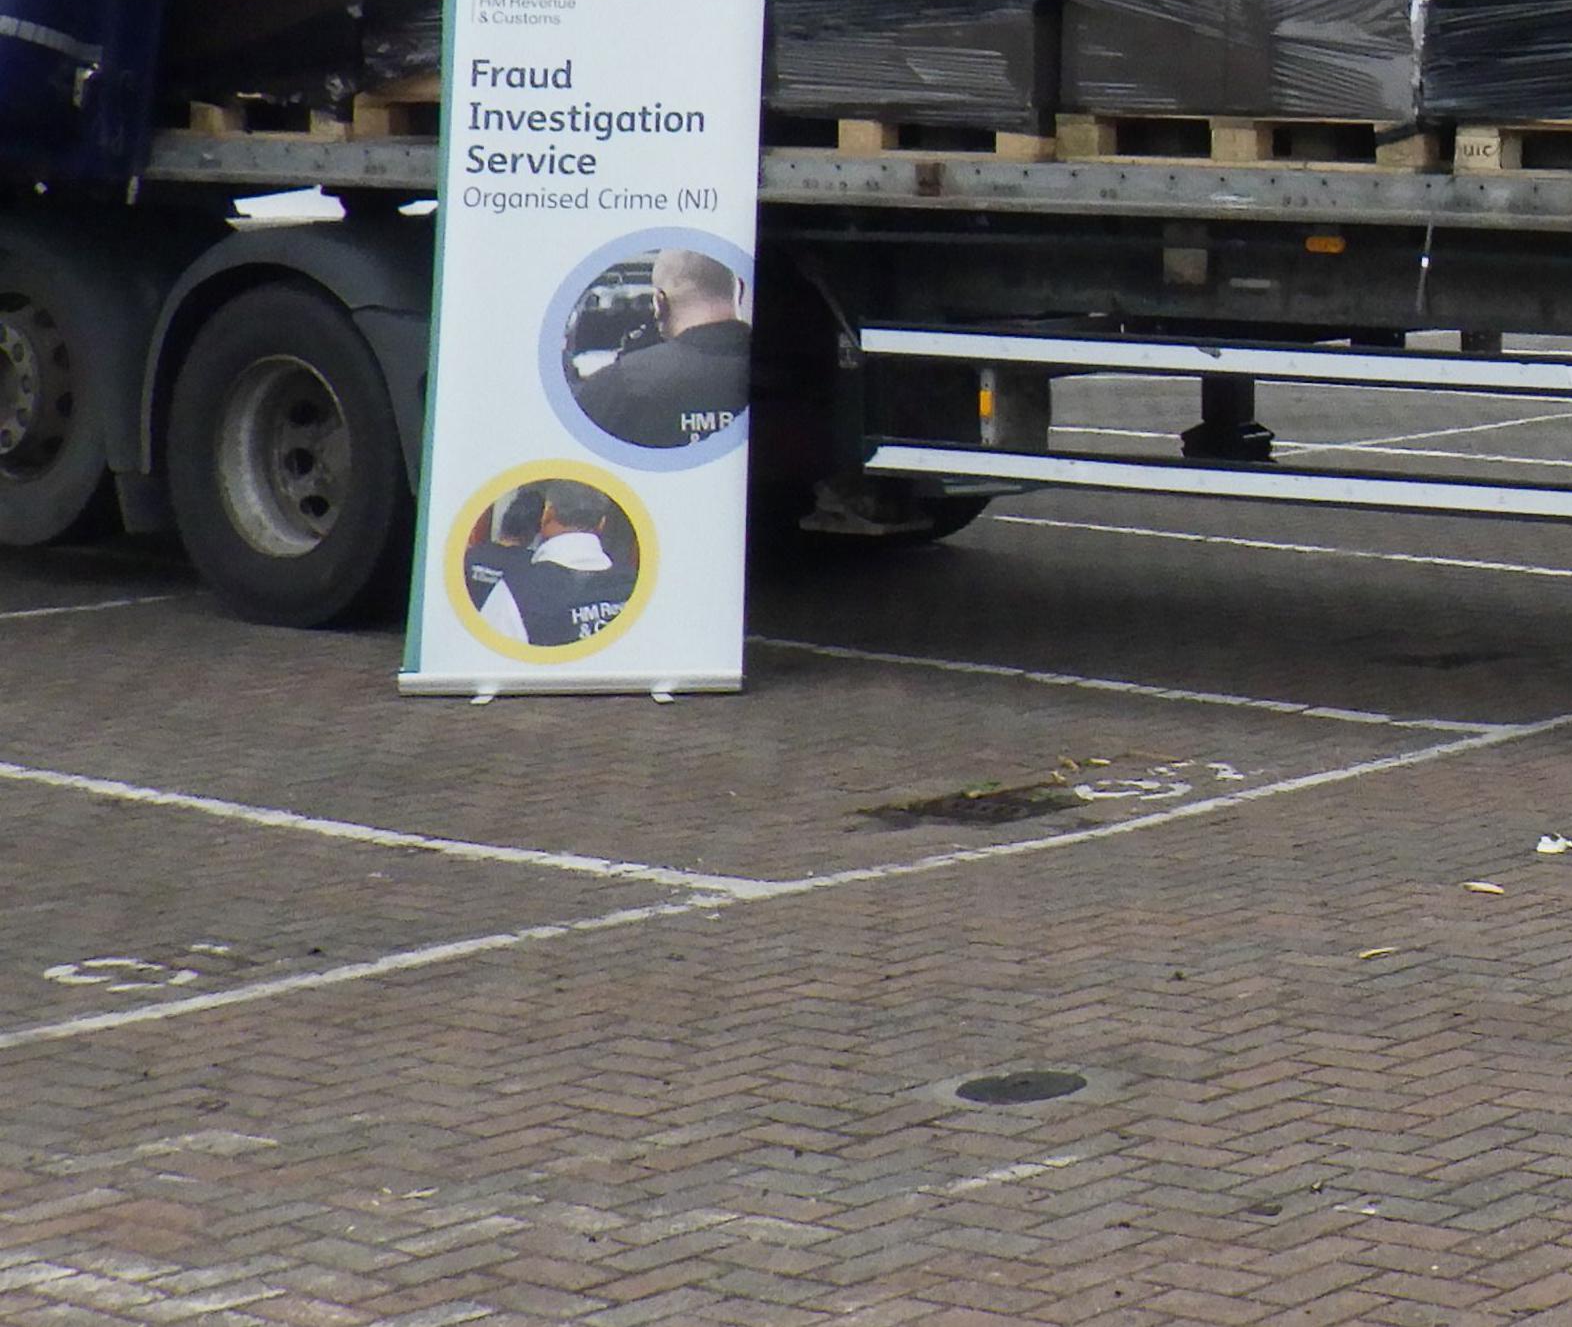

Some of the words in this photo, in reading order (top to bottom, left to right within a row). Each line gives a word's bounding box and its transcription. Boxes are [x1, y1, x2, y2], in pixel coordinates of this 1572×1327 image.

[492, 10, 562, 26] Customs
[470, 59, 572, 89] Fraud
[468, 101, 705, 141] Investigation
[465, 145, 597, 175] Service
[463, 187, 589, 213] Organised
[598, 188, 668, 210] Crime
[677, 187, 718, 213] (NI)
[681, 413, 716, 431] HM
